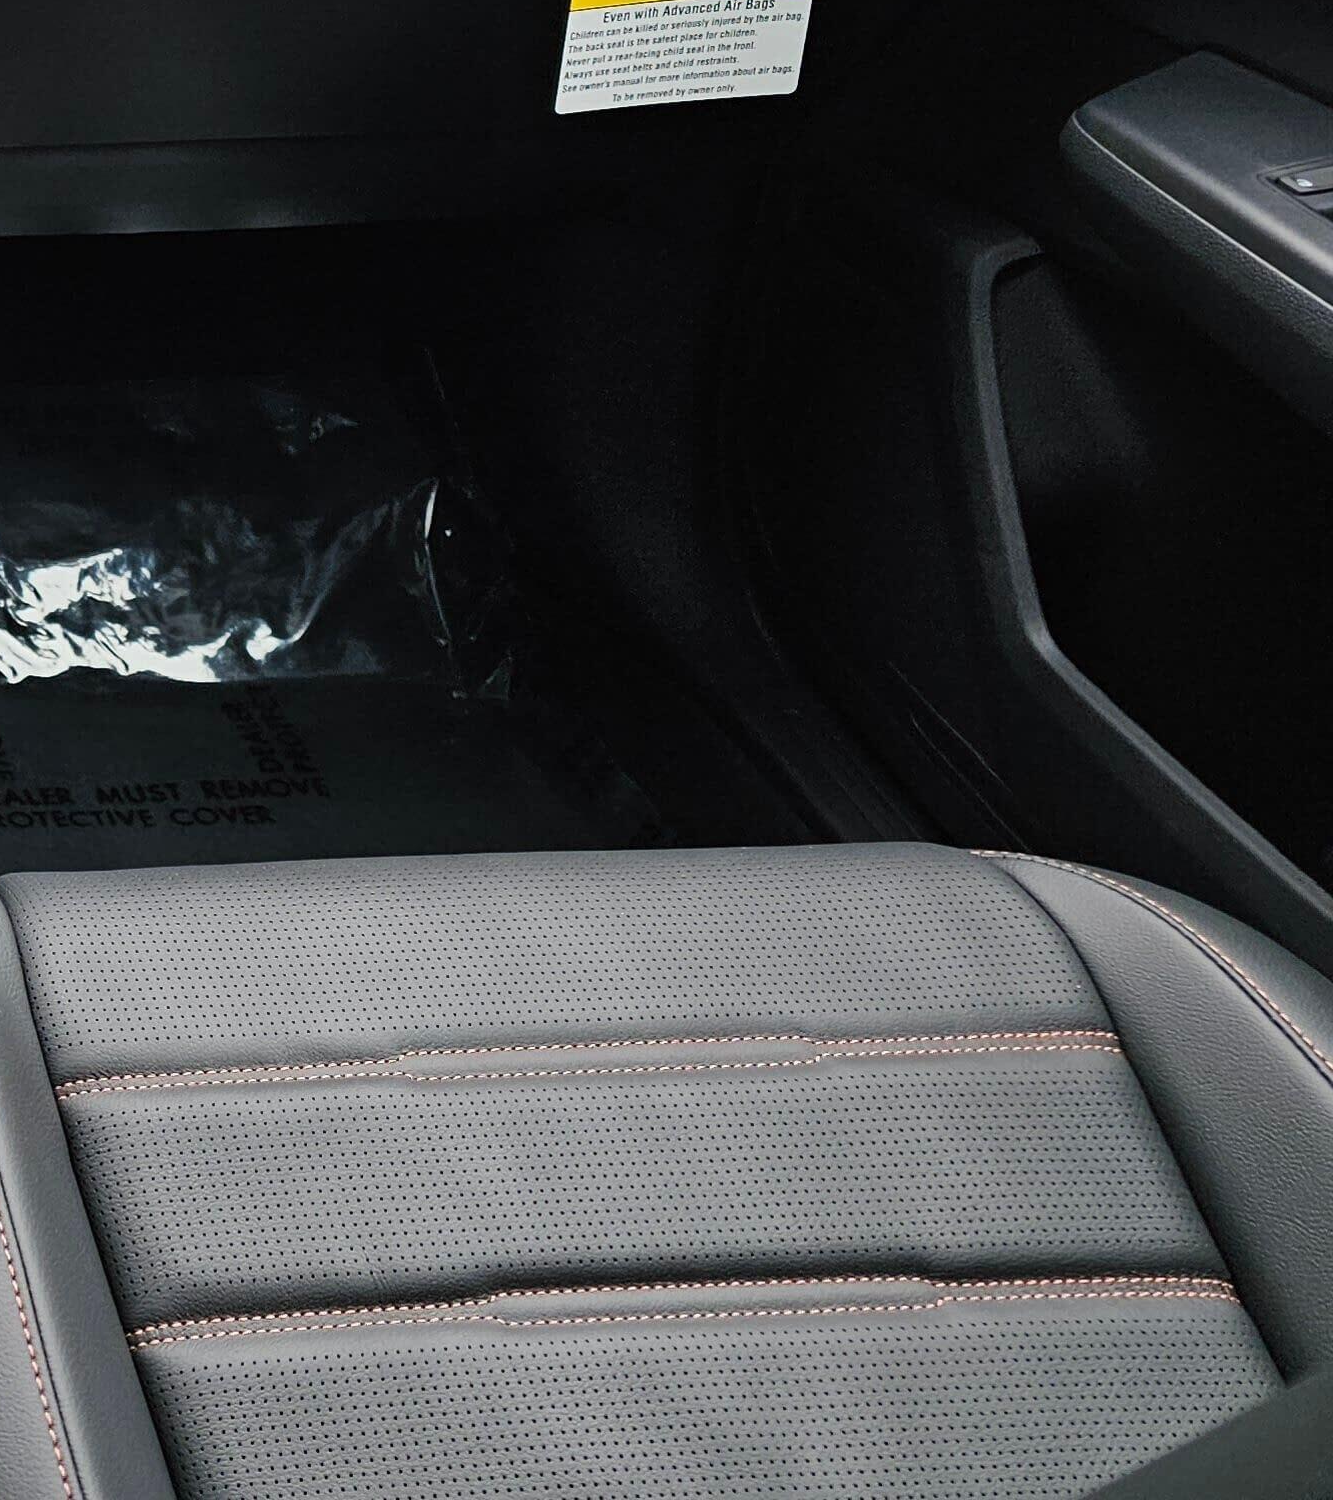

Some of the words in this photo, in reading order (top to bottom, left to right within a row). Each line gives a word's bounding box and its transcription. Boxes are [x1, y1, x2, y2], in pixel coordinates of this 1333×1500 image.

[603, 11, 631, 23] Even
[634, 8, 659, 20] with
[662, 1, 721, 17] Advanced
[724, 0, 743, 11] Air
[570, 29, 607, 41] Children
[606, 28, 621, 37] can
[623, 26, 633, 35] be
[635, 23, 658, 33] killed
[660, 23, 669, 31] or
[671, 19, 709, 30] seriously
[711, 16, 741, 27] injured
[743, 16, 754, 25] by
[755, 14, 769, 23] the
[772, 13, 784, 21] air
[785, 12, 804, 22] bag.
[569, 45, 583, 54] The
[585, 42, 604, 52] back
[607, 40, 625, 49] seat
[636, 37, 650, 46] the
[653, 34, 678, 44] safest
[680, 32, 703, 42] place
[705, 31, 718, 39] for
[720, 28, 757, 39] children.
[564, 70, 593, 80] Always
[595, 68, 610, 76] use
[612, 65, 631, 75] seat
[633, 62, 654, 72] belts
[655, 61, 671, 70] and
[673, 58, 694, 68] child
[696, 55, 740, 66] restraints.
[566, 57, 590, 67] Never
[592, 55, 606, 64] put
[663, 46, 685, 56] child
[686, 45, 705, 55] seat
[706, 44, 716, 52] in
[717, 43, 731, 52] the
[562, 84, 577, 93] See
[579, 81, 611, 92] owner's
[613, 76, 644, 86] manual
[645, 75, 657, 83] for
[658, 73, 680, 82] more
[682, 68, 731, 80] information
[732, 67, 756, 76] about
[757, 65, 770, 74] air
[771, 65, 795, 75] bags.
[613, 93, 622, 102] To
[624, 92, 634, 100] be
[636, 88, 673, 99] removed
[675, 87, 686, 97] by
[687, 86, 714, 95] owner
[95, 782, 182, 805] MUST
[199, 776, 331, 800] REMOVE
[169, 804, 276, 828] COVER
